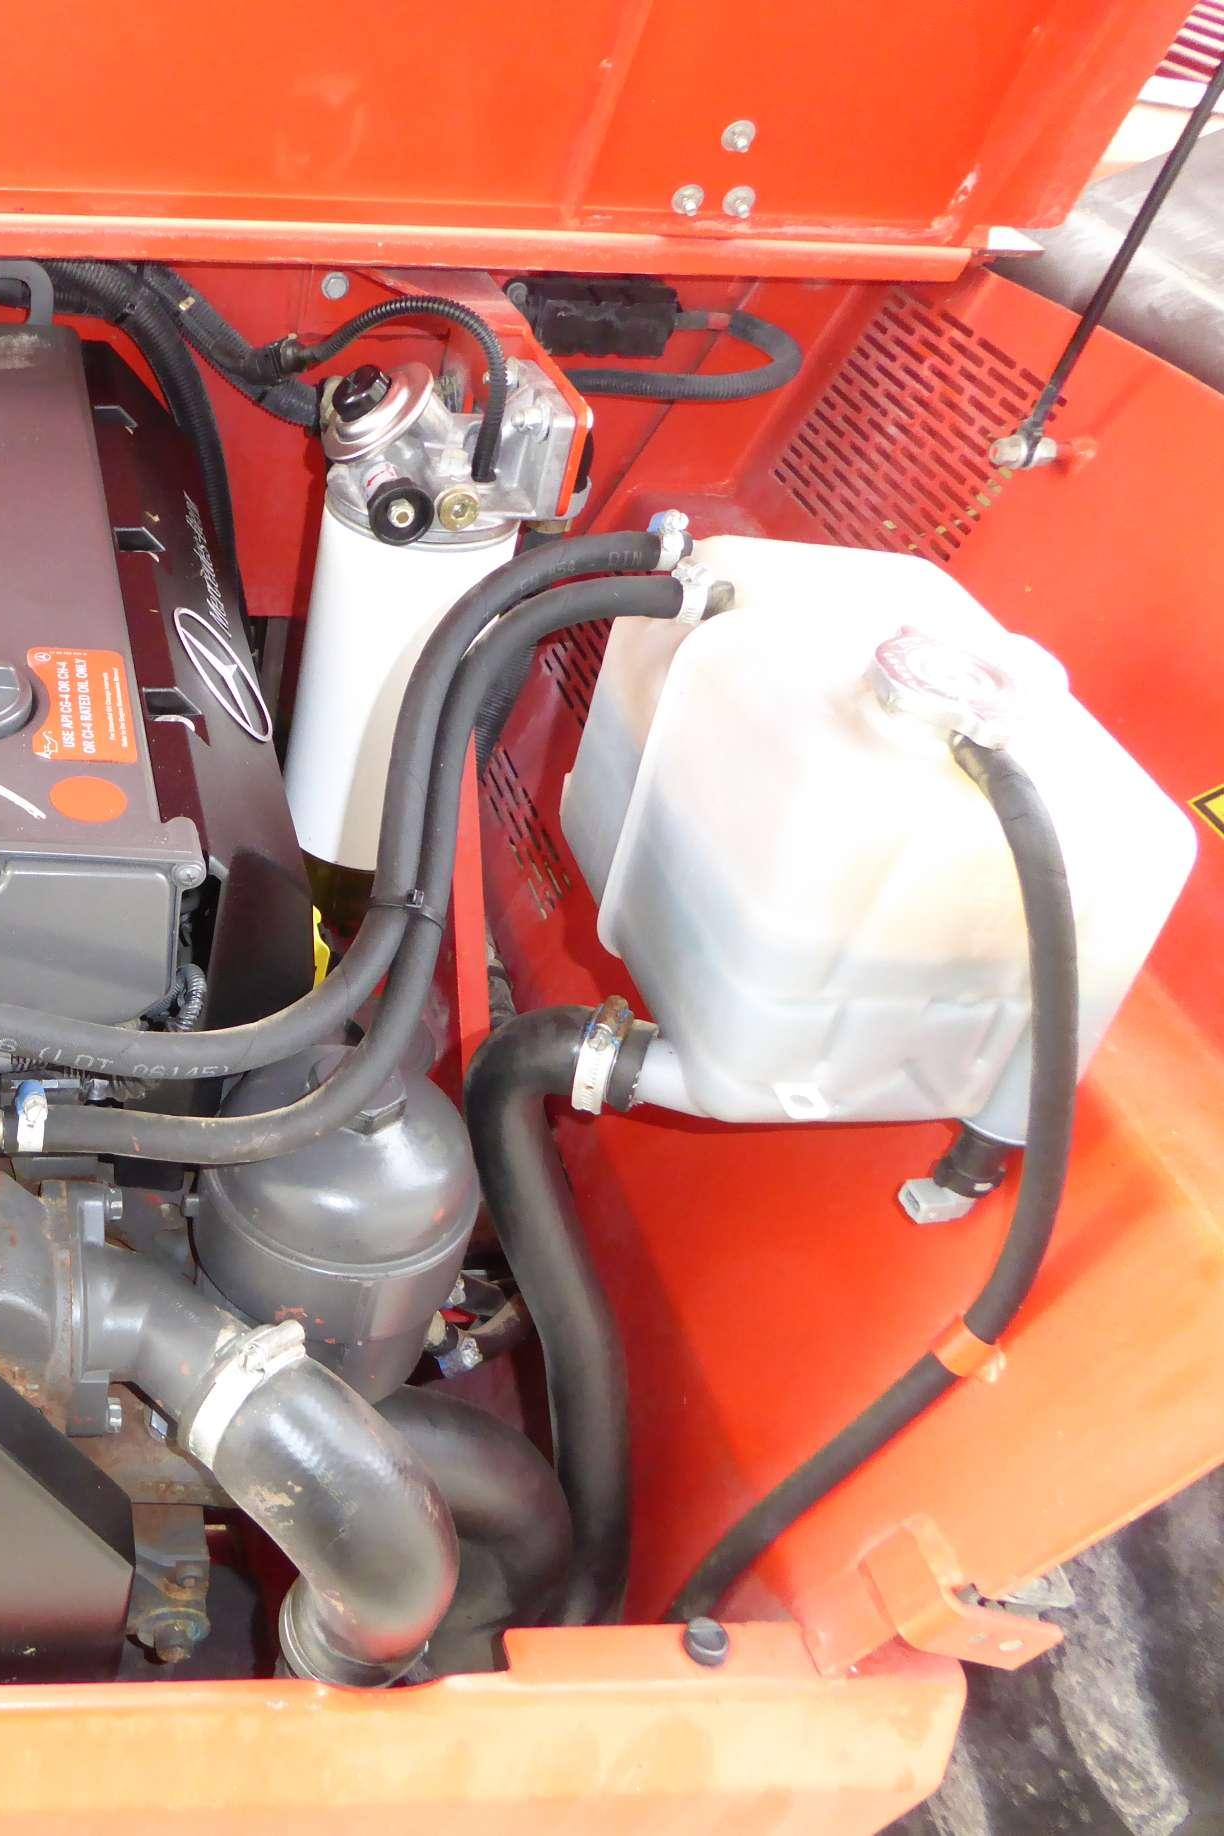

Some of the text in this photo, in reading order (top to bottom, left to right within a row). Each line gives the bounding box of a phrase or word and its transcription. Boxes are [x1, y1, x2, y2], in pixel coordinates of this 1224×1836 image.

[56, 661, 75, 748] USE API CG-4 OR CH-4
[74, 658, 96, 754] OR CI-4 RATED OIL ONLY
